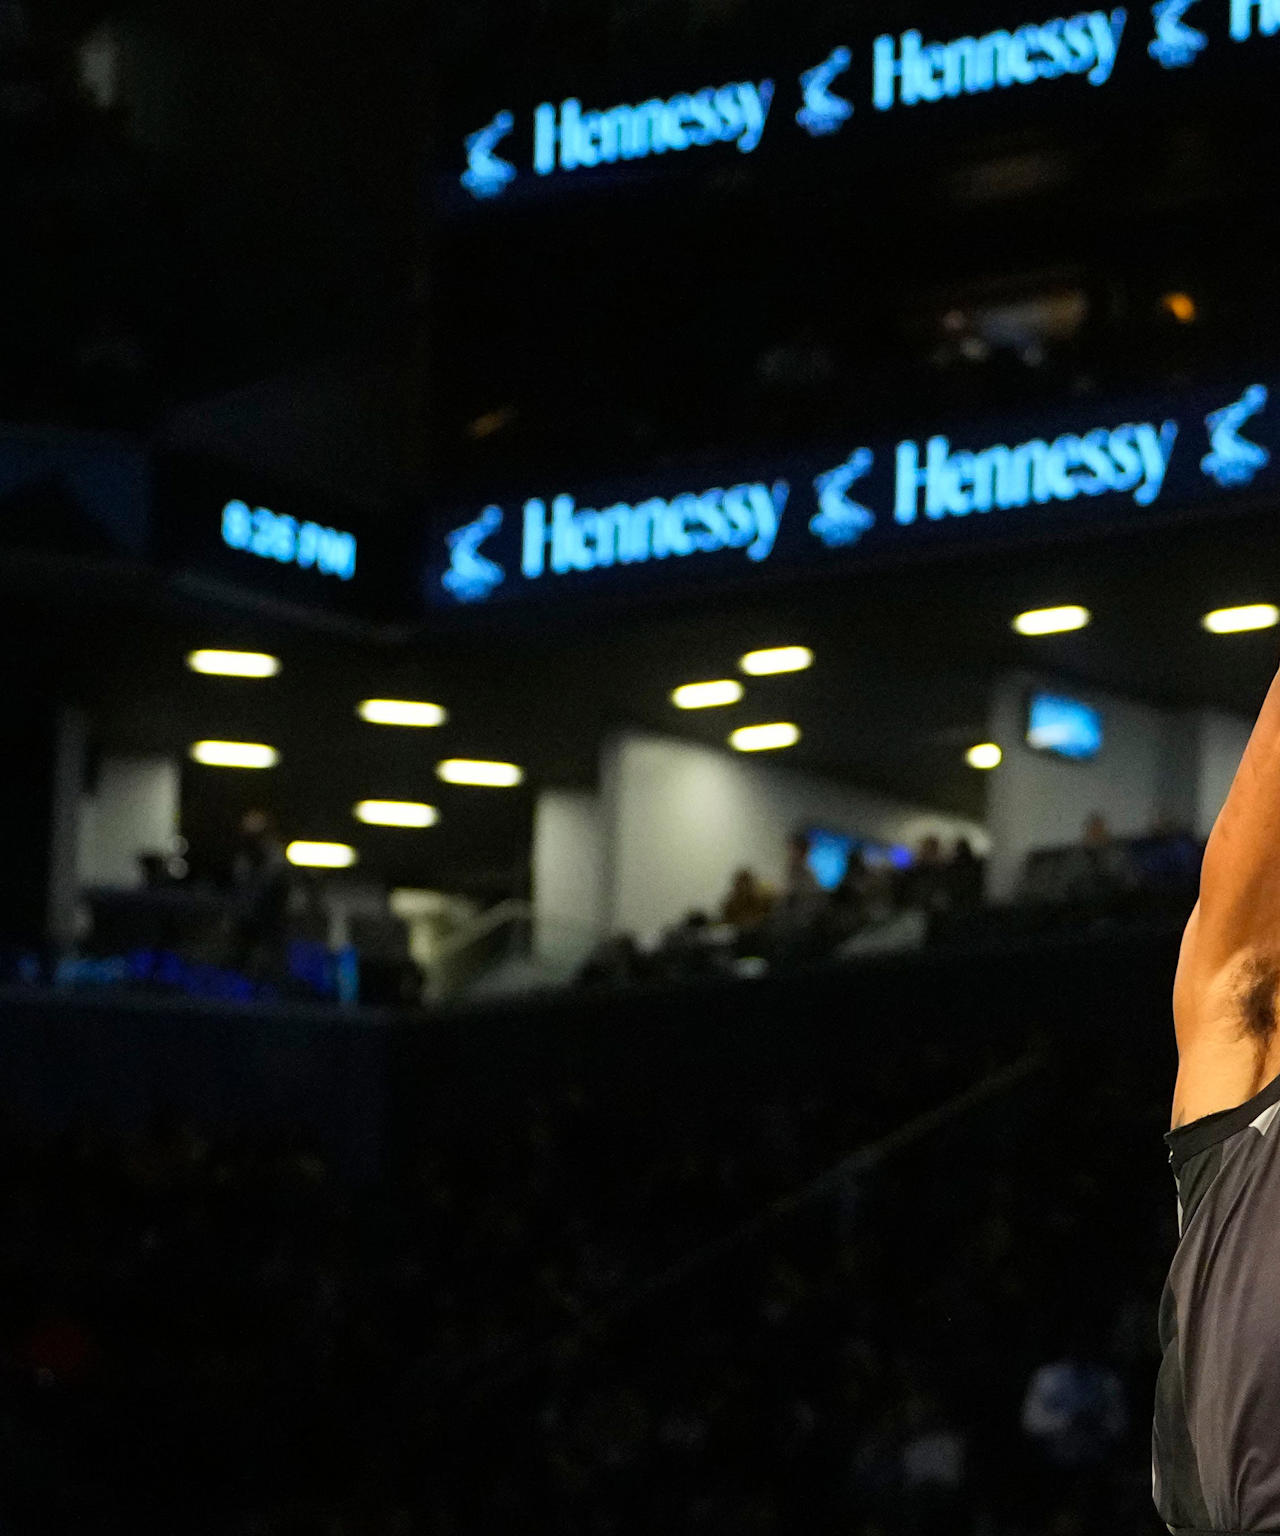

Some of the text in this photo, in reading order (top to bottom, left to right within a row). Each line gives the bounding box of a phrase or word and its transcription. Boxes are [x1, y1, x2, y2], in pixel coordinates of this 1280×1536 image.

[873, 6, 1127, 112] Hennessy
[534, 77, 775, 176] Hennessy
[894, 419, 1179, 525] Hennessy
[521, 479, 790, 579] Hennessy
